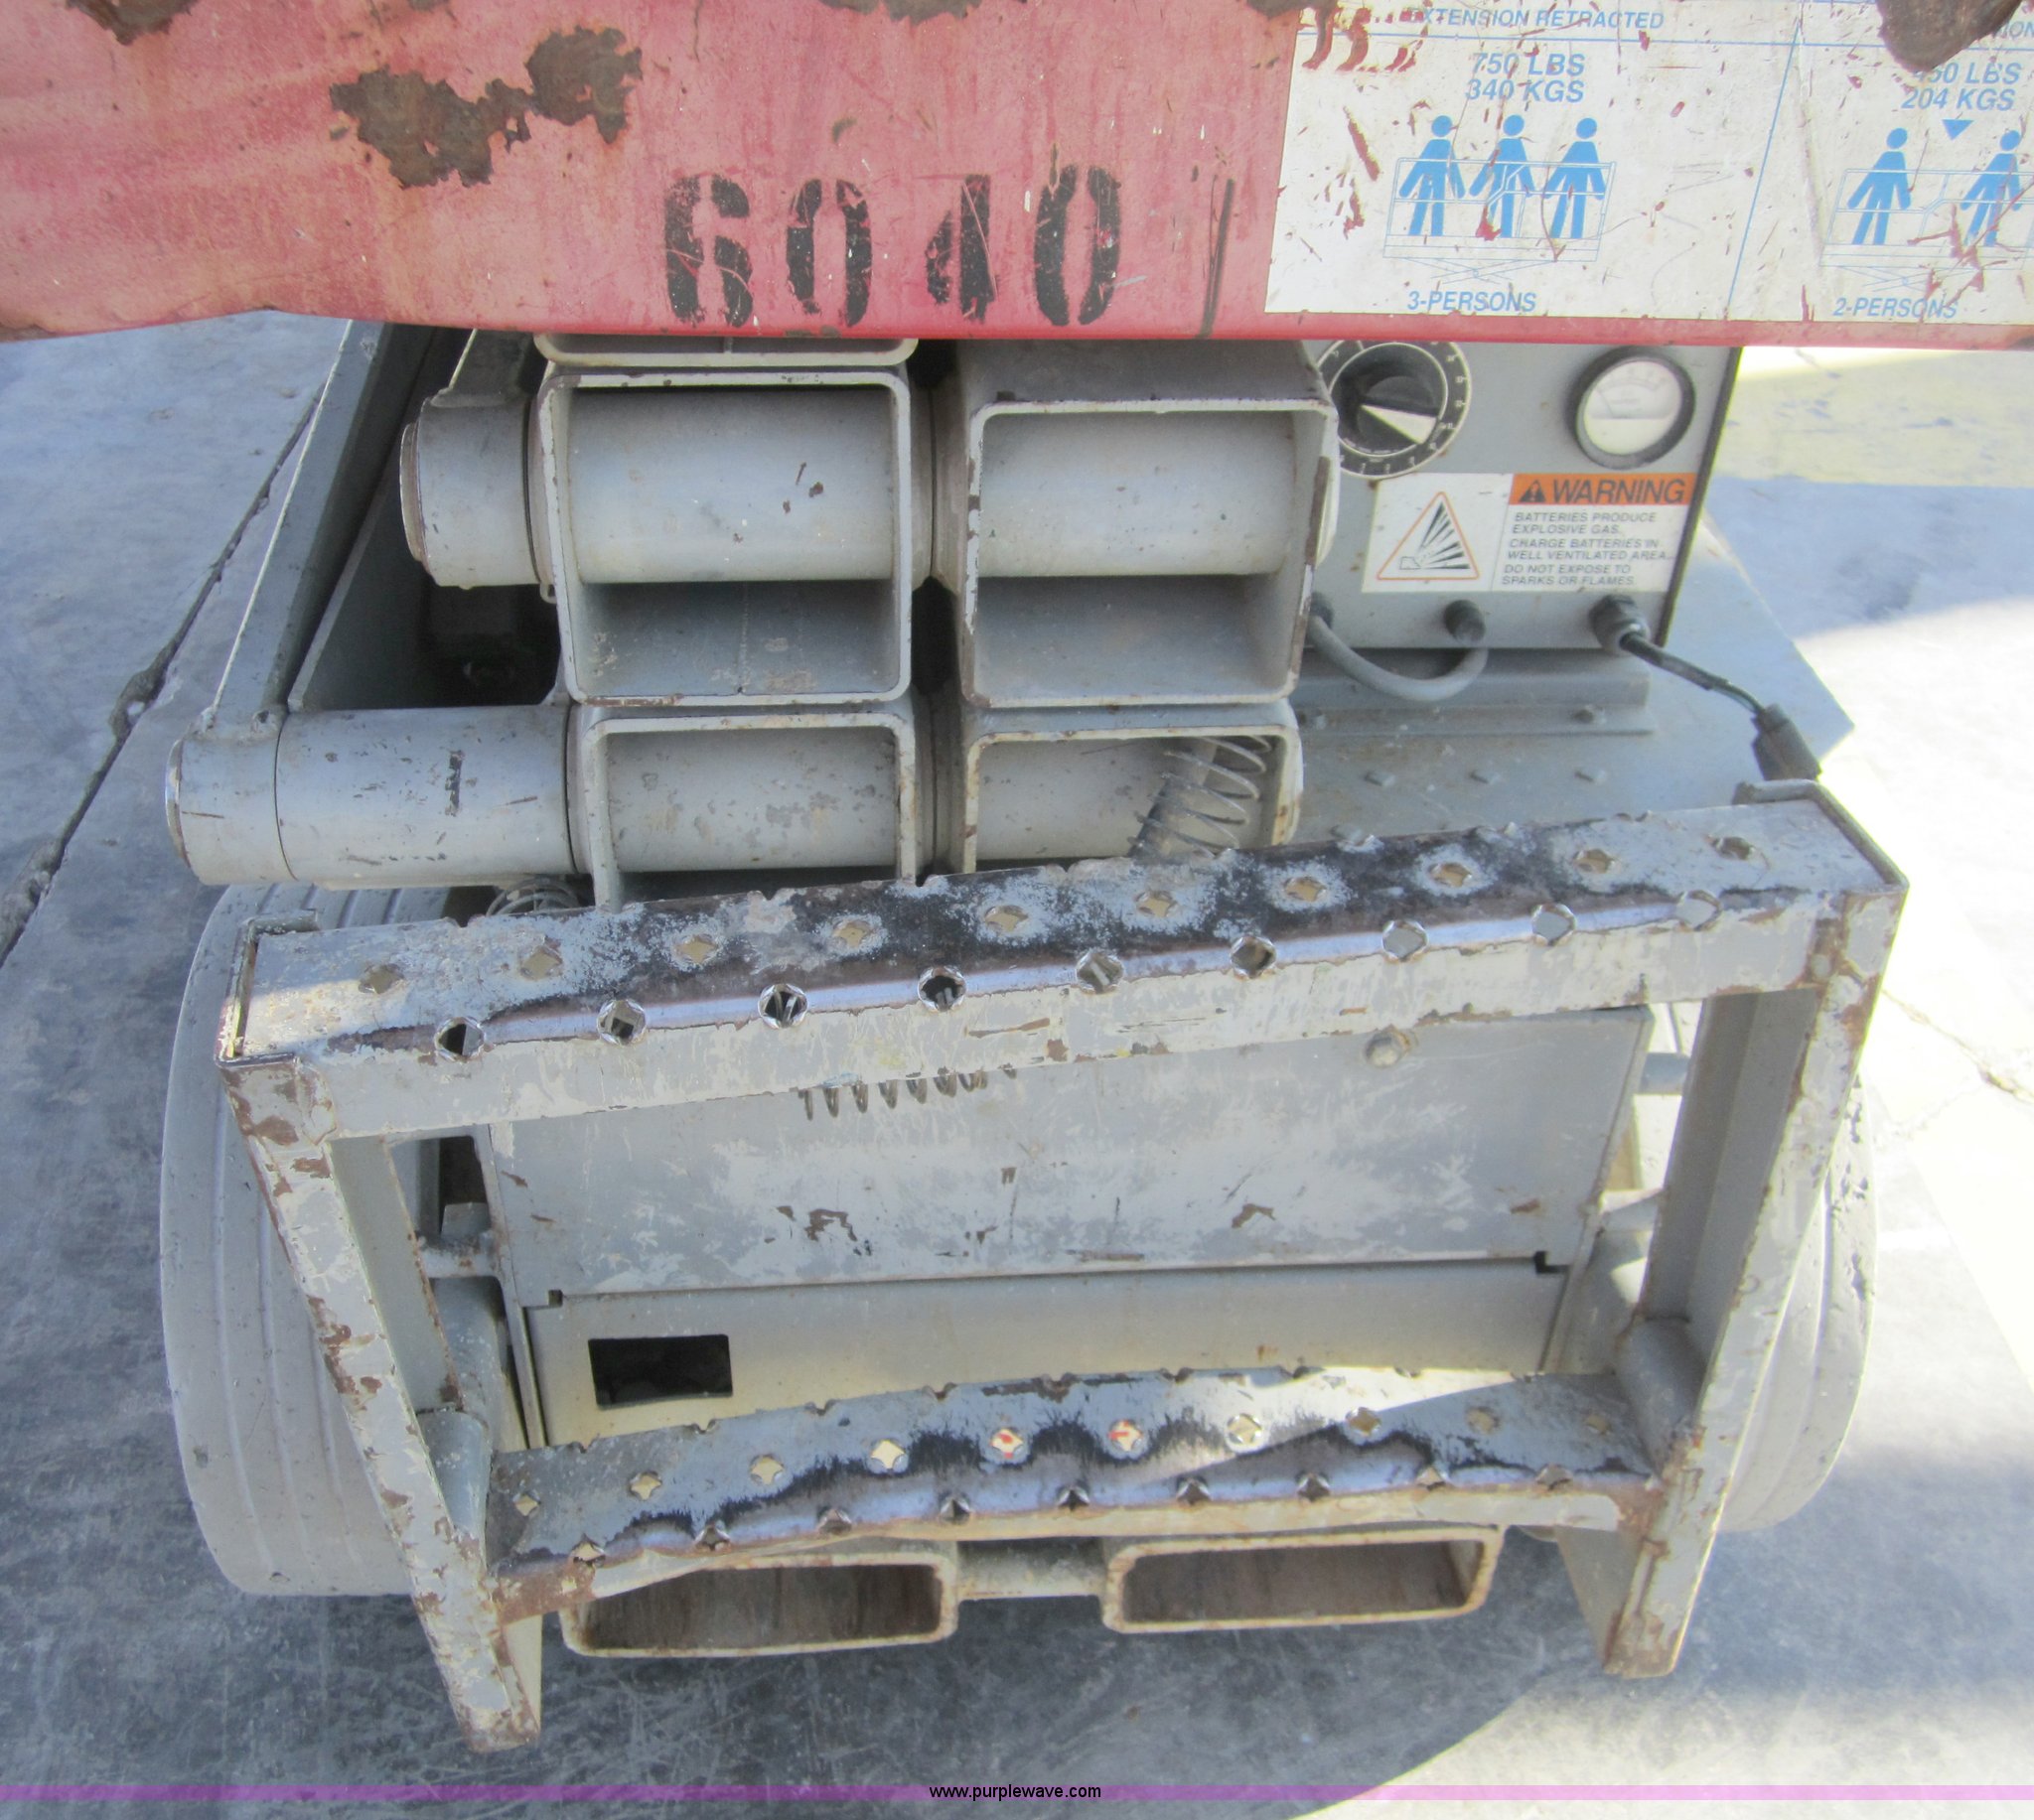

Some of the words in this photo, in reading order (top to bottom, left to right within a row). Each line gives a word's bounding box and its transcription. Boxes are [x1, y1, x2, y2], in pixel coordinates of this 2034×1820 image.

[1535, 10, 1665, 29] RETRACTED
[1473, 53, 1519, 75] 750
[1527, 54, 1586, 76] LBS
[1963, 62, 2022, 84] LBS
[1465, 78, 1515, 101] 340
[1523, 79, 1585, 103] KGS
[1901, 87, 1949, 109] 204
[1956, 88, 2016, 111] KGS
[1407, 291, 1537, 312] 3-PERSONS
[1832, 298, 1959, 319] 2-PERSONS
[1551, 479, 1685, 504] WARNING
[1514, 511, 1589, 522] BATTERIES
[1591, 512, 1658, 522] PRODUCE
[1512, 524, 1587, 534] EXPLOSIVE
[1510, 538, 1566, 548] CHARGE
[1570, 538, 1643, 548] BATTERIES
[1645, 539, 1660, 548] IN
[1508, 550, 1543, 560] WELL
[1546, 550, 1628, 560] VENTILATED
[1504, 564, 1524, 574] DO
[1527, 564, 1554, 574] NOT
[1558, 564, 1610, 575] EXPOSE
[1614, 564, 1632, 574] TO
[1502, 576, 1555, 586] SPARKS
[1558, 576, 1578, 586] OR
